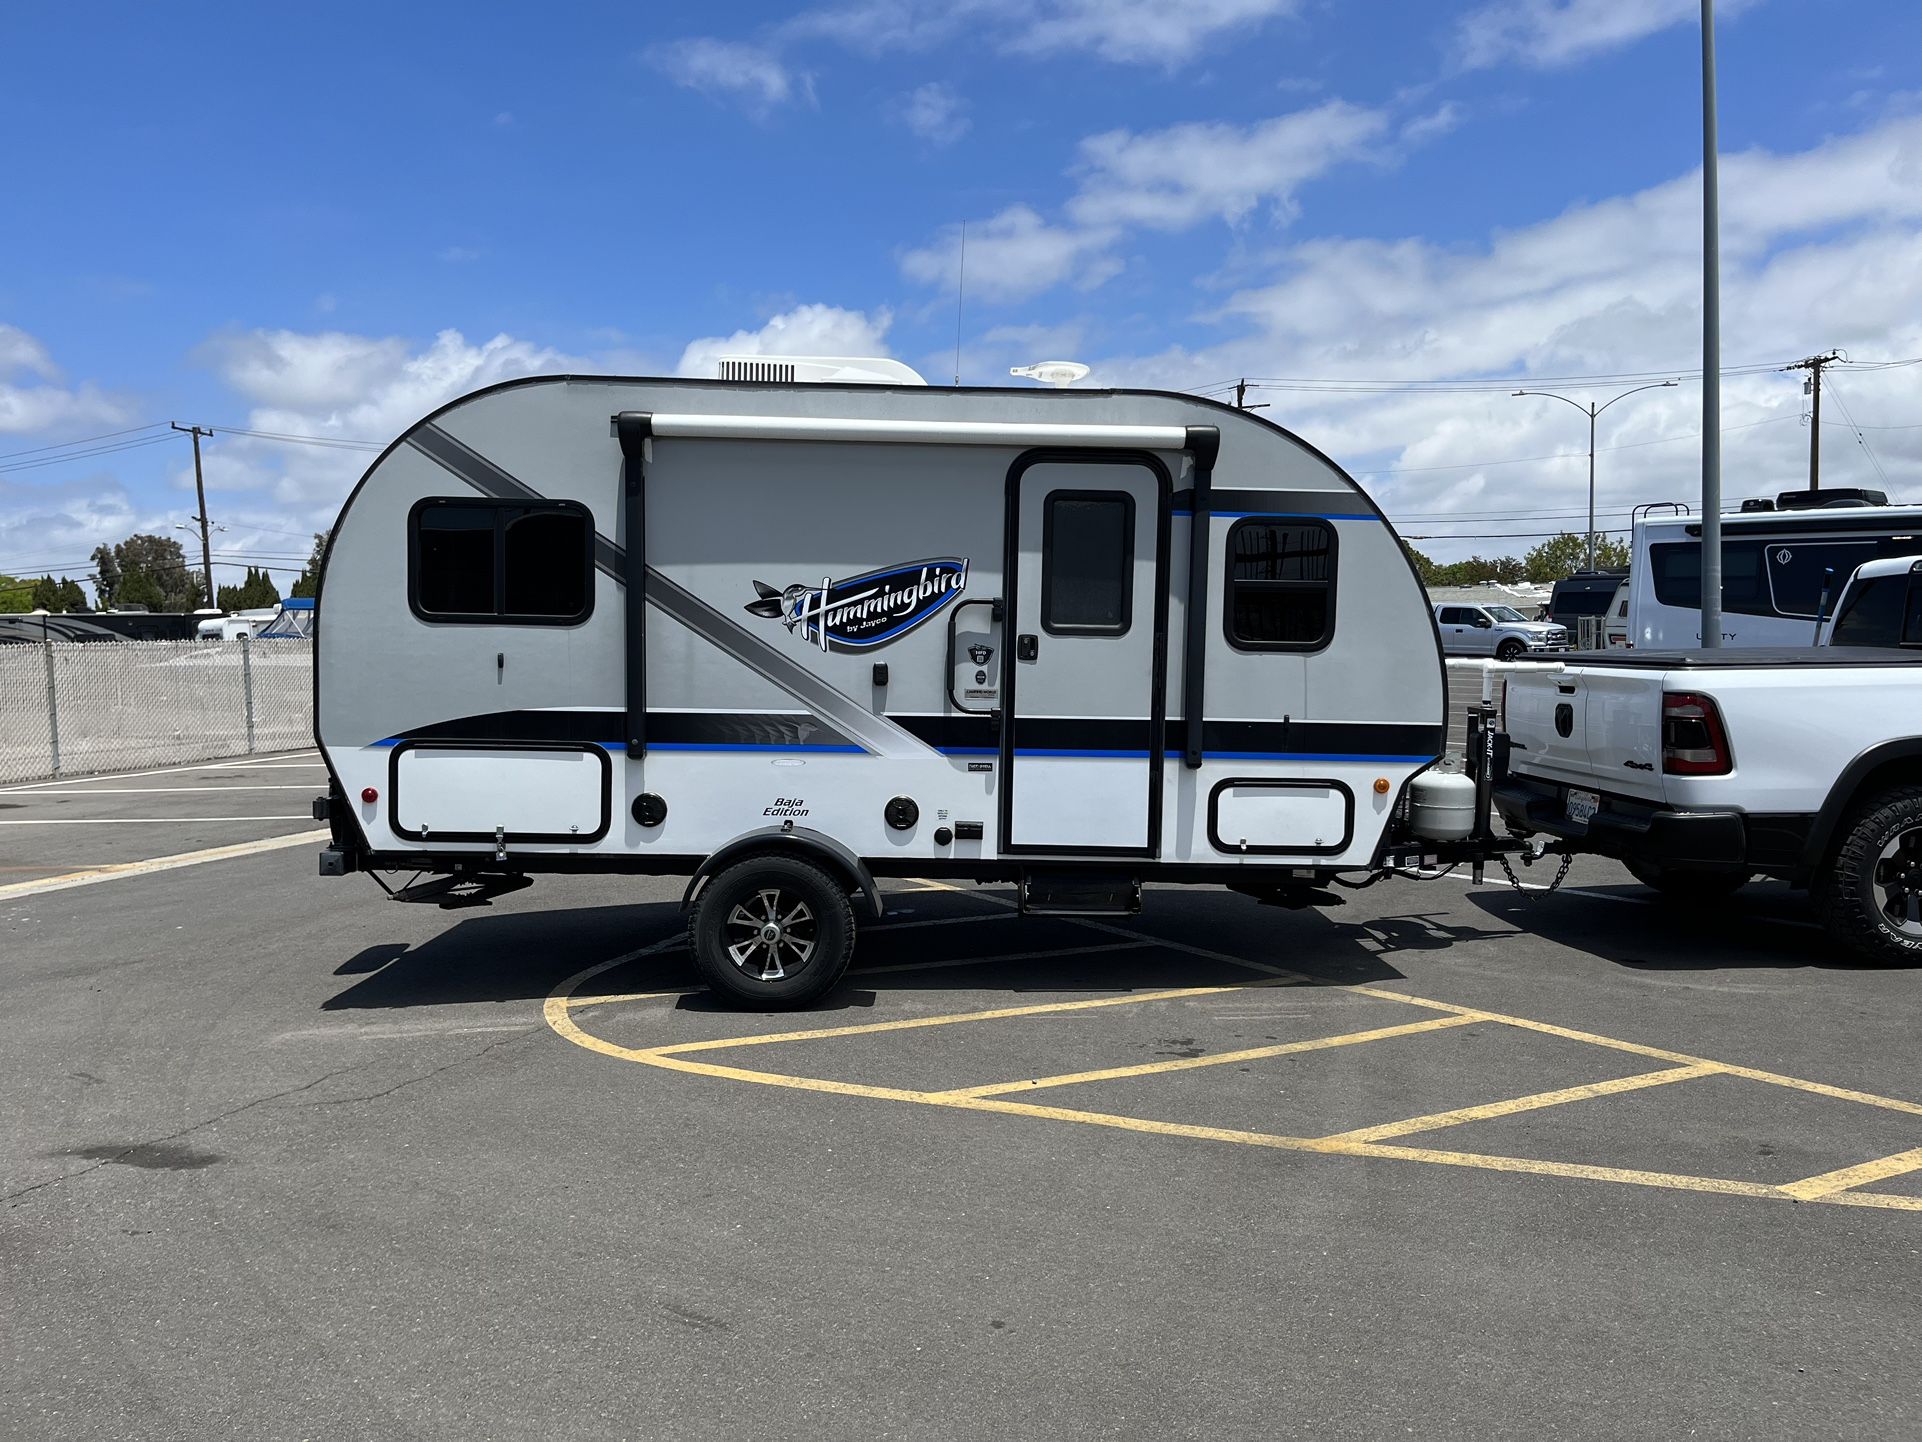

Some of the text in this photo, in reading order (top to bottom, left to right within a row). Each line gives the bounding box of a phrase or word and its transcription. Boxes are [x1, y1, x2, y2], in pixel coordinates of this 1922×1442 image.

[794, 557, 969, 652] Hummingbird
[847, 617, 887, 633] by Jayco
[1696, 632, 1737, 641] UTY
[1486, 730, 1494, 759] JACK-IT
[774, 797, 804, 808] Baja
[762, 807, 810, 817] Edition
